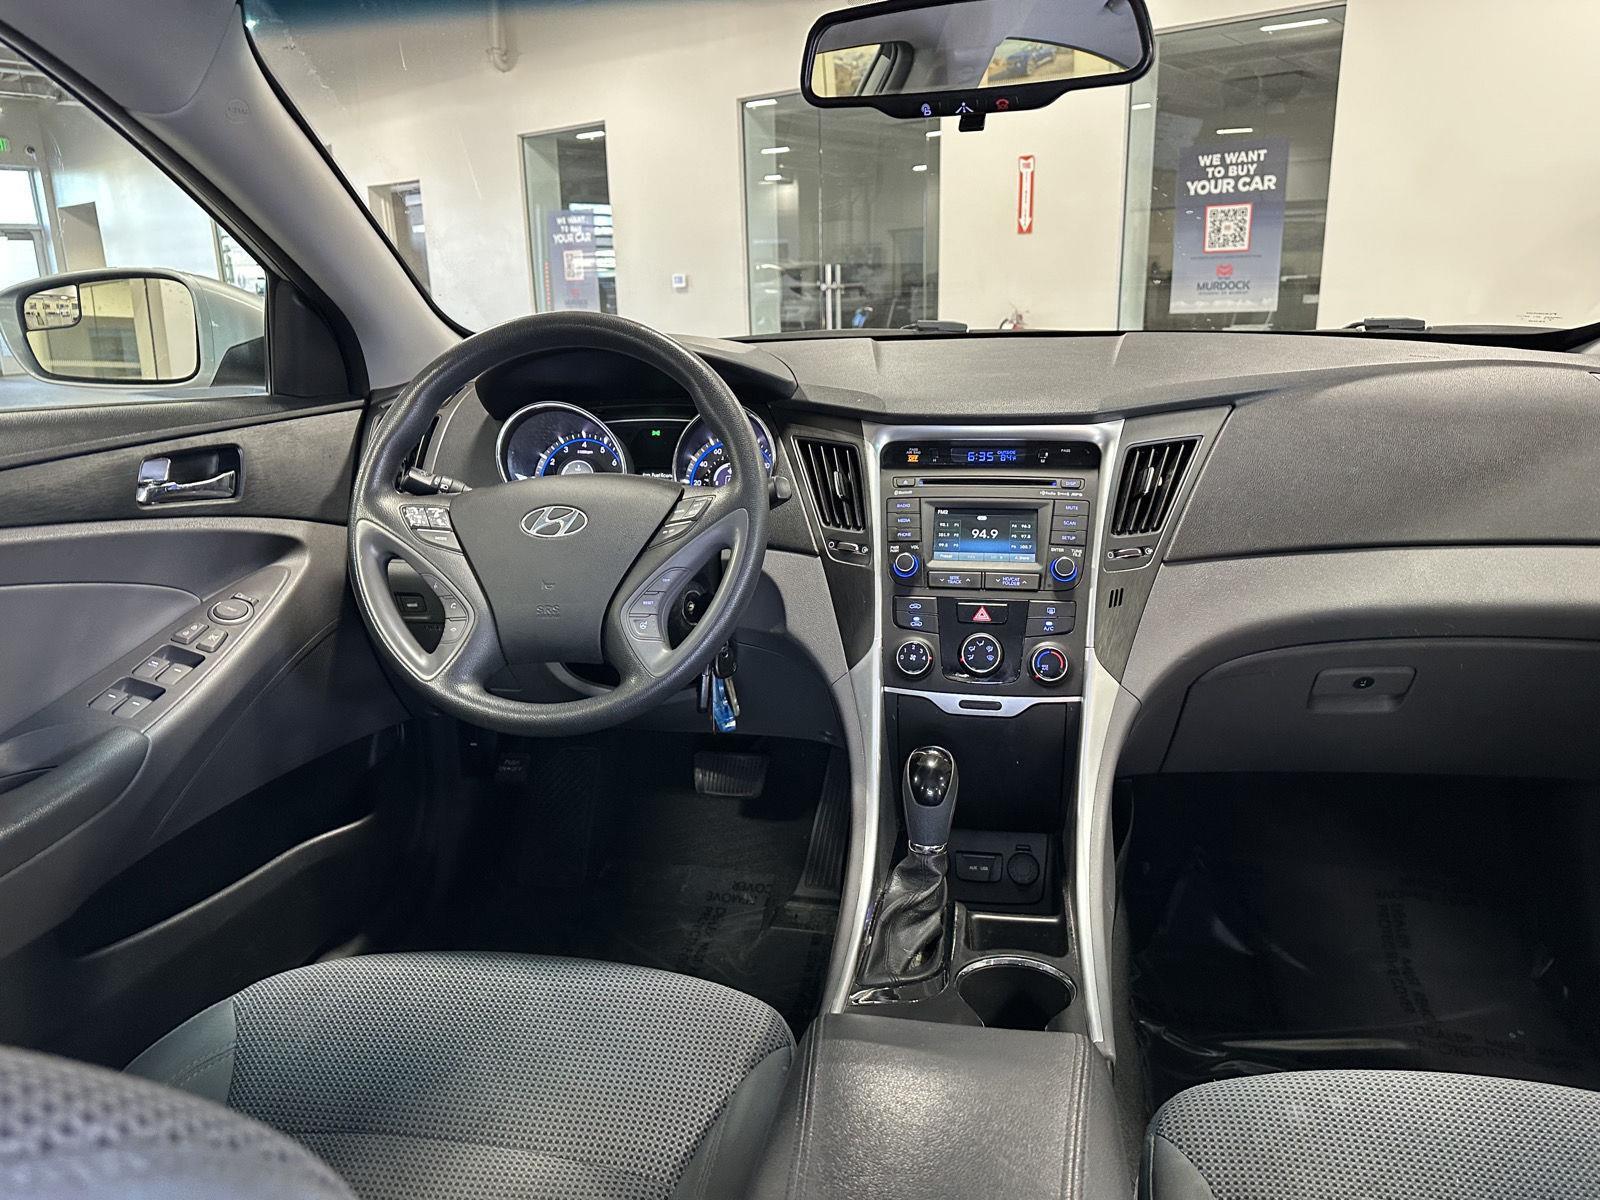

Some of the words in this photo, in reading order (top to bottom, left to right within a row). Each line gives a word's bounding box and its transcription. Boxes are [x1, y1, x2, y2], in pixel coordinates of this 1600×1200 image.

[1198, 153, 1222, 167] WE
[1224, 149, 1267, 164] WANT
[1206, 166, 1225, 178] TO
[1228, 163, 1258, 177] BUY
[1186, 178, 1235, 196] YOUR
[1238, 175, 1277, 192] CAR
[1196, 280, 1251, 291] MURDOCK
[967, 451, 994, 461] 6:35
[549, 458, 556, 466] 2
[612, 458, 618, 467] 6
[971, 528, 999, 539] 94.9
[536, 604, 560, 617] SRS
